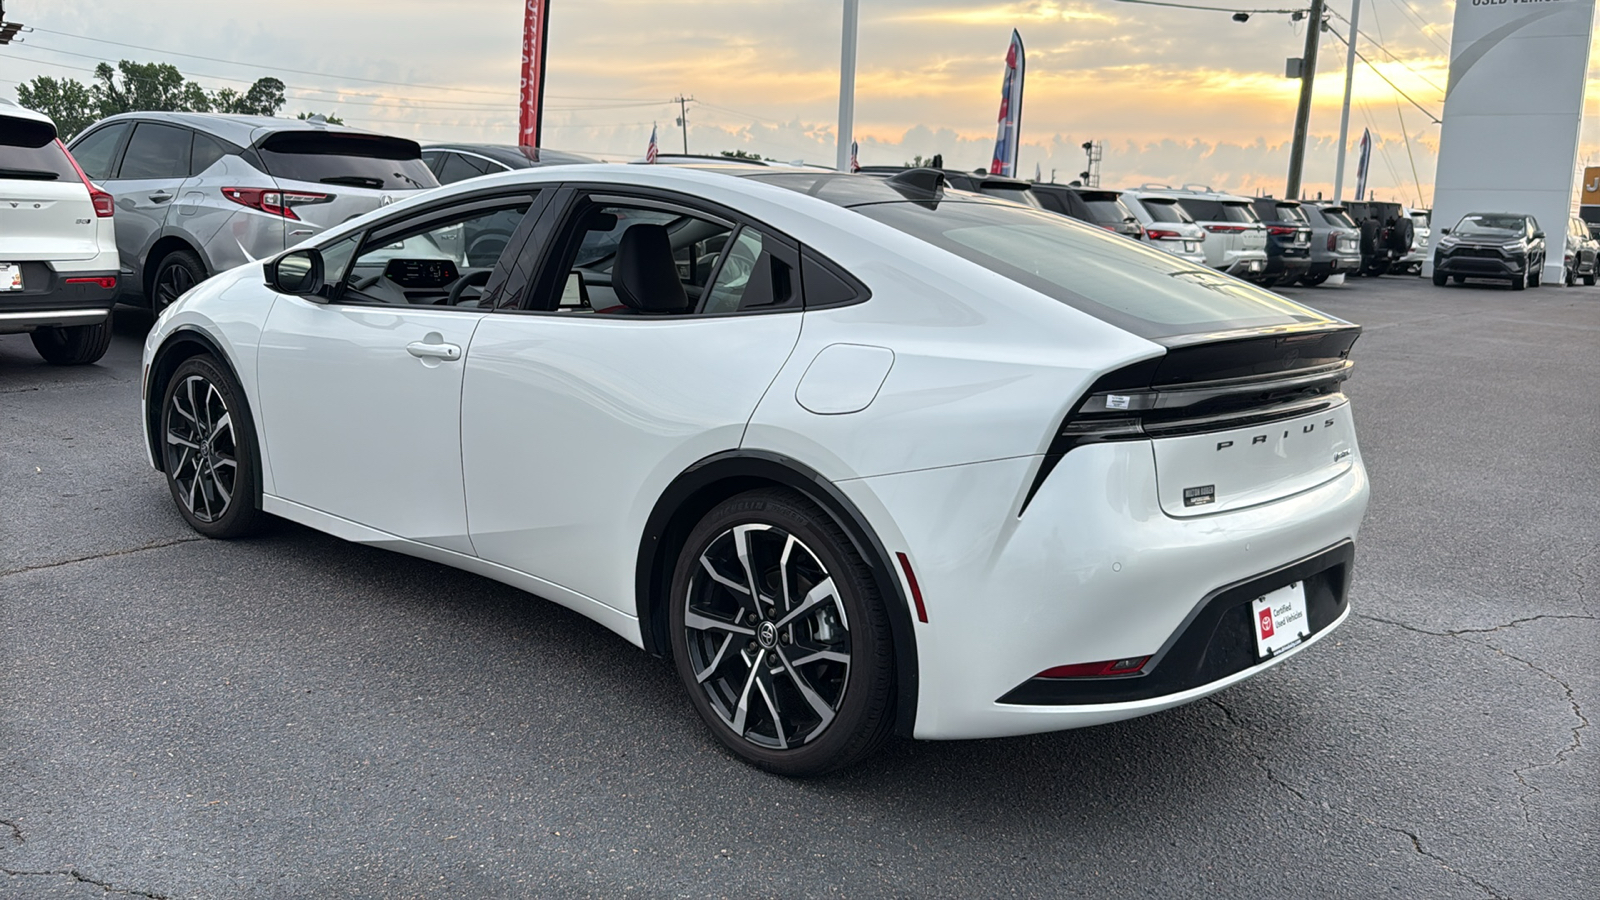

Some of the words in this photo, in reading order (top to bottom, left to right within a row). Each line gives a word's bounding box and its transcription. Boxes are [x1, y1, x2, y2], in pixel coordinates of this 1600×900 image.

[1216, 418, 1334, 451] PRIUS
[1273, 602, 1292, 616] Certified
[1275, 617, 1286, 628] Used
[1286, 611, 1303, 622] Vehicles
